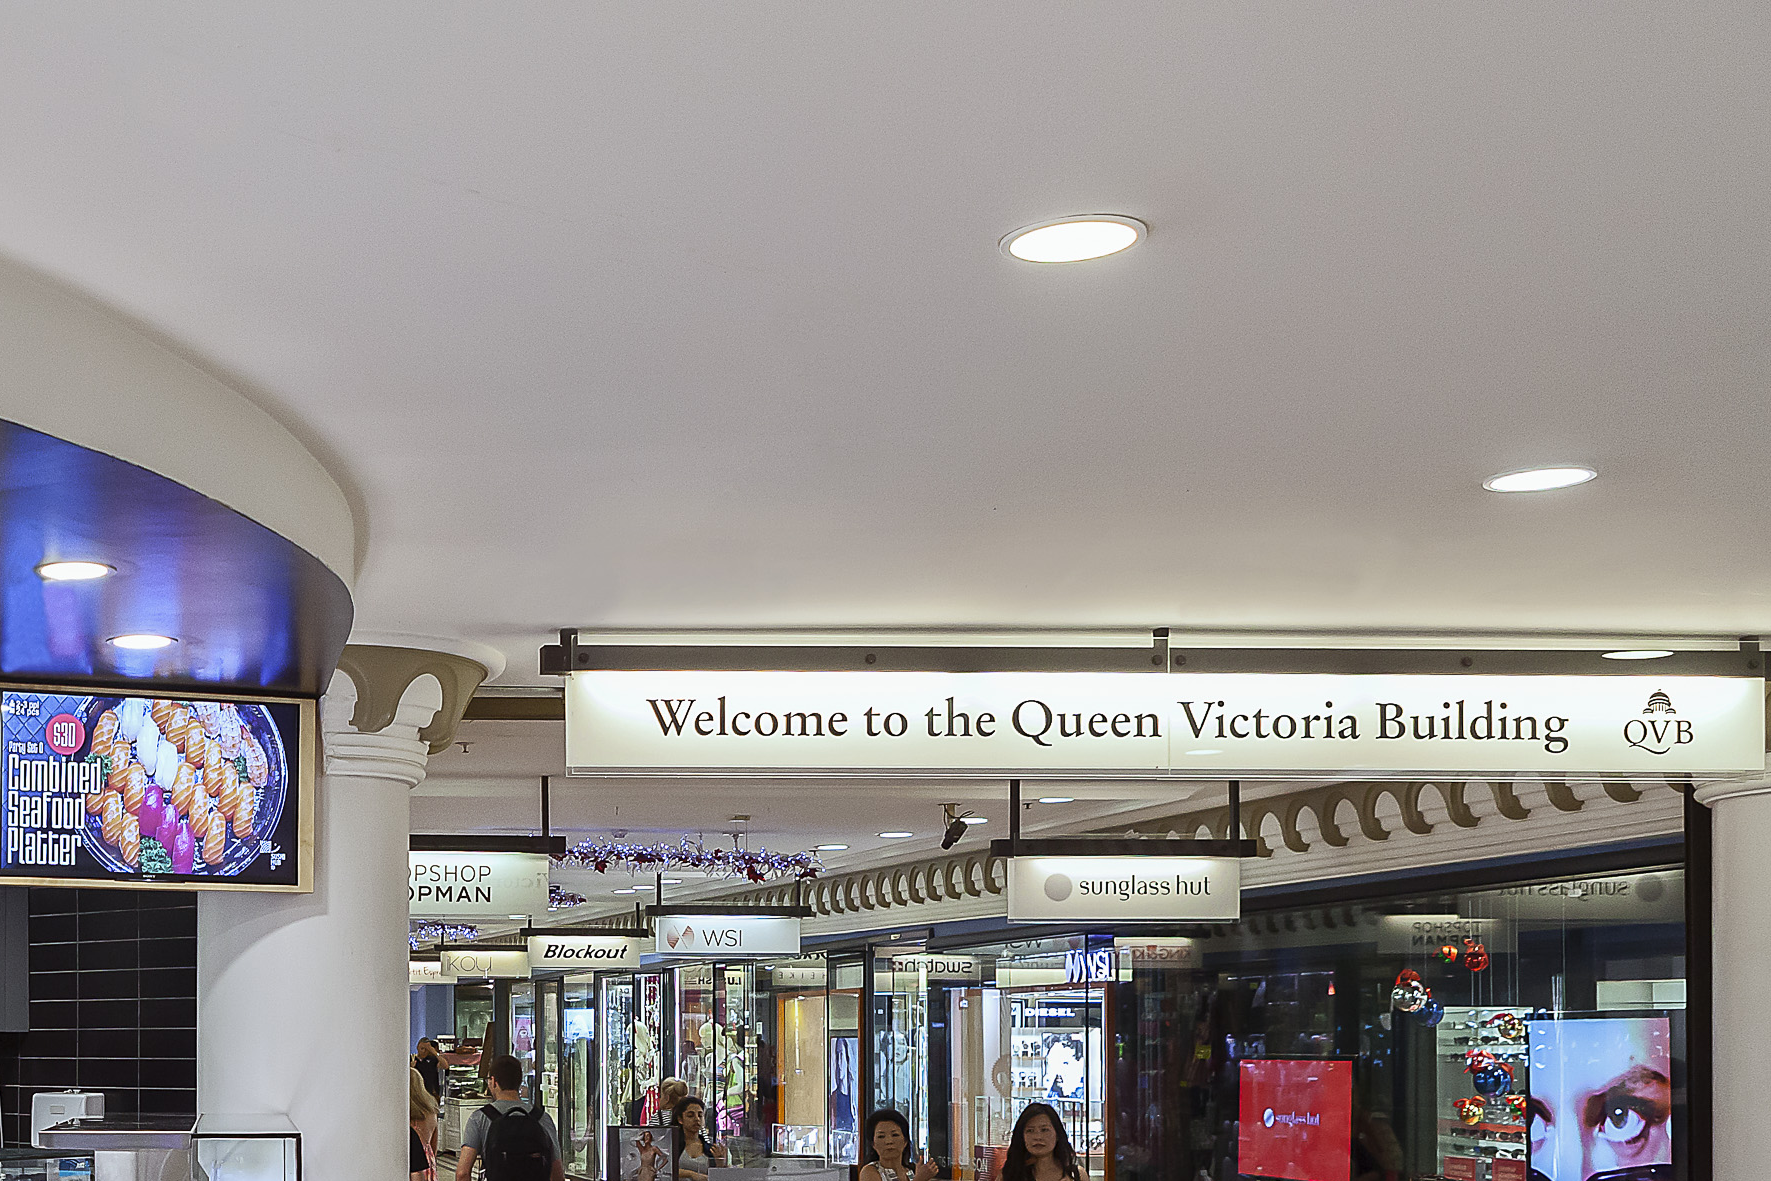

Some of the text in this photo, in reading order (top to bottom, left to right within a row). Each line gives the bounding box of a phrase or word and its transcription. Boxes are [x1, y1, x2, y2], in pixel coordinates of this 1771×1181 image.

[53, 722, 76, 747] $30
[647, 696, 1570, 753] Welcome to the Queen Victoria Building
[1624, 719, 1695, 755] QVB
[8, 741, 38, 754] Party Set
[8, 754, 101, 794] Combined
[7, 792, 85, 829] Seafood
[7, 827, 81, 866] Platter
[408, 864, 491, 882] PSHOP
[1079, 874, 1211, 901] sunglass hut
[543, 943, 628, 959] Blockout
[702, 929, 742, 947] WSI
[1024, 1007, 1075, 1017] DIESEL
